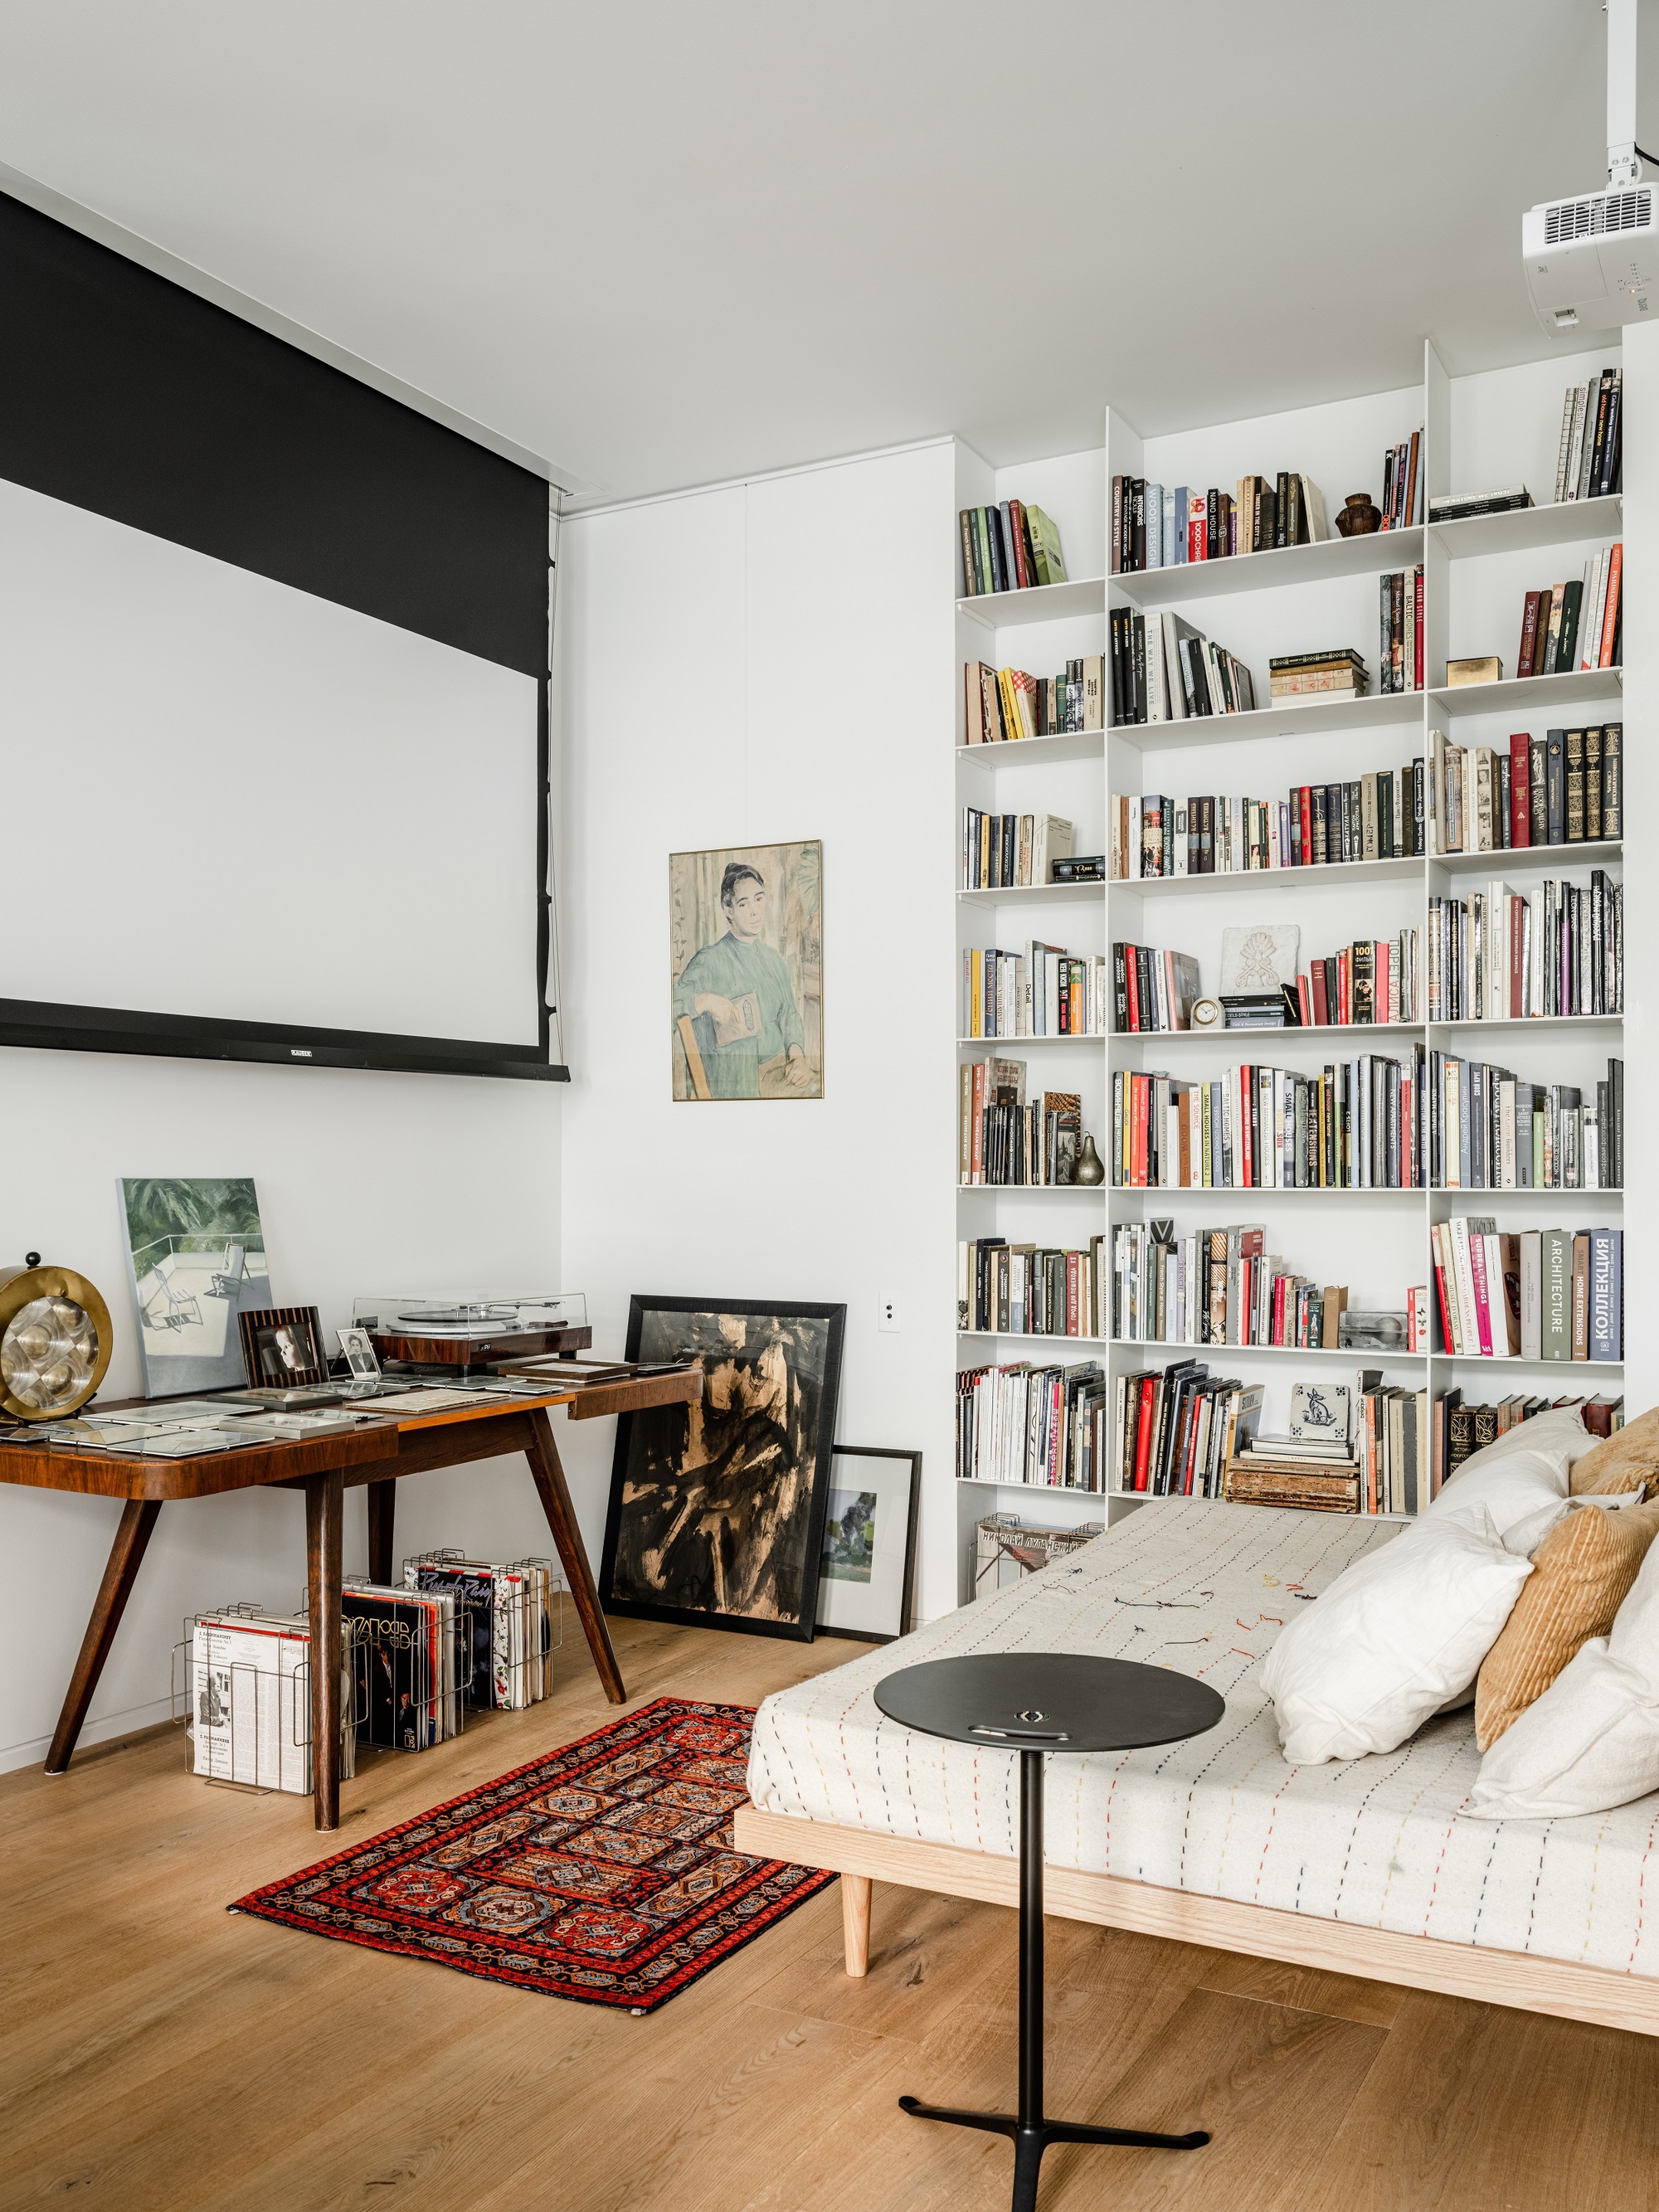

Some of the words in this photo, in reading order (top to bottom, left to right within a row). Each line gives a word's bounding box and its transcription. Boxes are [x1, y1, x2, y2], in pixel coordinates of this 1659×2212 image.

[1149, 527, 1157, 566] DESIGN
[1609, 571, 1618, 604] PARISIAN
[1605, 605, 1614, 644] INTERIORS
[1149, 670, 1154, 683] WE
[1389, 939, 1399, 979] ПОРЕТ
[1389, 980, 1399, 1022] АЛИСА
[1461, 1087, 1469, 1123] Красулин
[1460, 1125, 1469, 1155] Андрей
[1475, 1238, 1484, 1272] SURREAL
[1478, 1275, 1487, 1304] THINGS
[1551, 1239, 1563, 1333] ARCHITECTURE
[1595, 1238, 1610, 1339] КОЛЛЕКЦИЯ
[1465, 1318, 1473, 1344] PEOPLE
[983, 1531, 1024, 1546] НИКОЛАЙ
